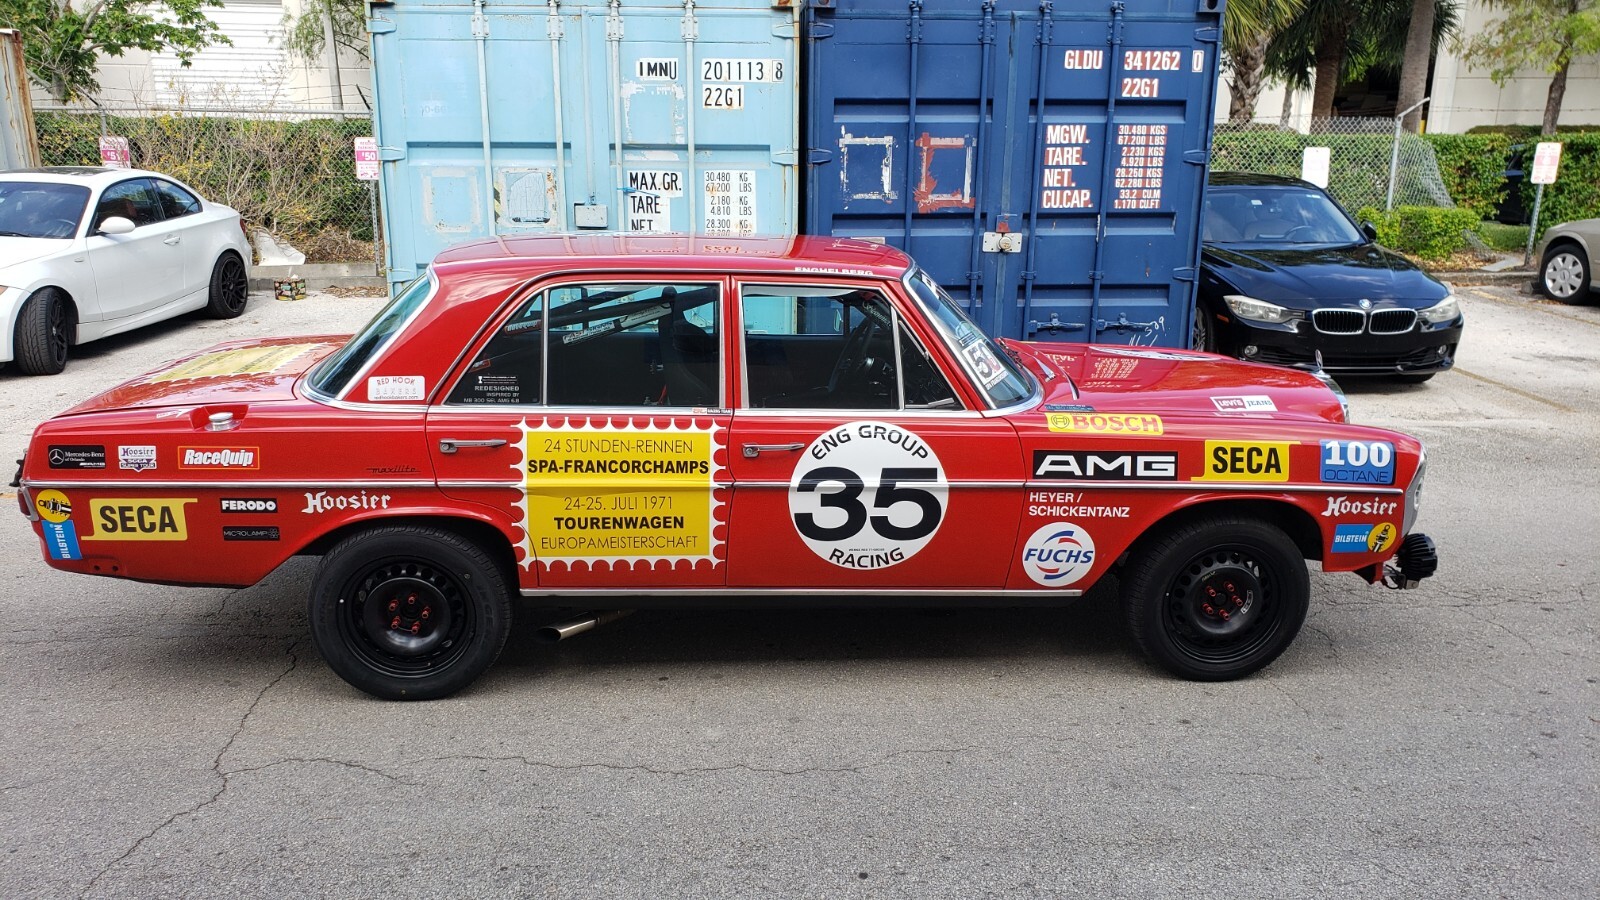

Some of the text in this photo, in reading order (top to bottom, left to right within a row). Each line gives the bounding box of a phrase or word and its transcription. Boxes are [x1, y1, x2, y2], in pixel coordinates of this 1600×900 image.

[1124, 51, 1204, 72] 341262 0
[639, 61, 677, 80] IMNU
[704, 61, 783, 80] 201113 8
[1121, 78, 1159, 98] 22G1
[704, 88, 742, 107] 22G1
[1046, 125, 1091, 144] MGW.
[1118, 125, 1166, 135] 30.480 KGS
[1117, 135, 1165, 145] 67.200 LBS
[1045, 147, 1088, 166] TARE.
[1121, 146, 1164, 156] 2.230 KGS
[1121, 157, 1163, 166] 4.920 LBS
[705, 172, 748, 182] 30.480 KG
[1043, 168, 1076, 187] NET.
[1146, 167, 1162, 177] KGS
[629, 172, 682, 191] MAX.GR.
[705, 183, 752, 192] 67.200 LBS
[1145, 178, 1161, 188] LBS
[710, 196, 748, 205] 2.180 KG
[1119, 189, 1137, 199] 33.2
[631, 196, 661, 214] TARE
[710, 206, 752, 215] 4.810 LBS
[1114, 199, 1137, 209] 1.170
[706, 219, 748, 229] 28.300 KG
[376, 377, 416, 386] RED HOOK
[1073, 415, 1160, 433] BOSCH
[544, 438, 693, 454] 24 STUNDEN-RENNEN
[812, 424, 929, 460] ENG GROUP
[183, 449, 254, 467] RaceQuip
[1212, 446, 1282, 474] SECA
[1325, 441, 1391, 468] 100
[528, 459, 709, 475] SPA-FRANCORCHAMPS
[1035, 454, 1176, 477] AMG
[1325, 469, 1389, 483] OCTANE
[221, 500, 276, 511] FERODO
[300, 490, 391, 514] Hoosier
[564, 495, 673, 511] 24-25. JULI 1971
[794, 466, 942, 542] 35
[1029, 492, 1074, 503] HEYER
[1028, 505, 1130, 518] SCHICKENTANZ
[1321, 496, 1398, 517] Hoosier
[99, 505, 179, 533] SECA
[554, 516, 684, 530] TOURENWAGEN
[53, 524, 72, 559] BILSTEIN
[541, 536, 698, 550] EUROPAMEISTERSCHAFT
[1334, 533, 1367, 543] BILSTEIN
[829, 547, 905, 568] RACING
[1024, 548, 1094, 564] FUCHS
